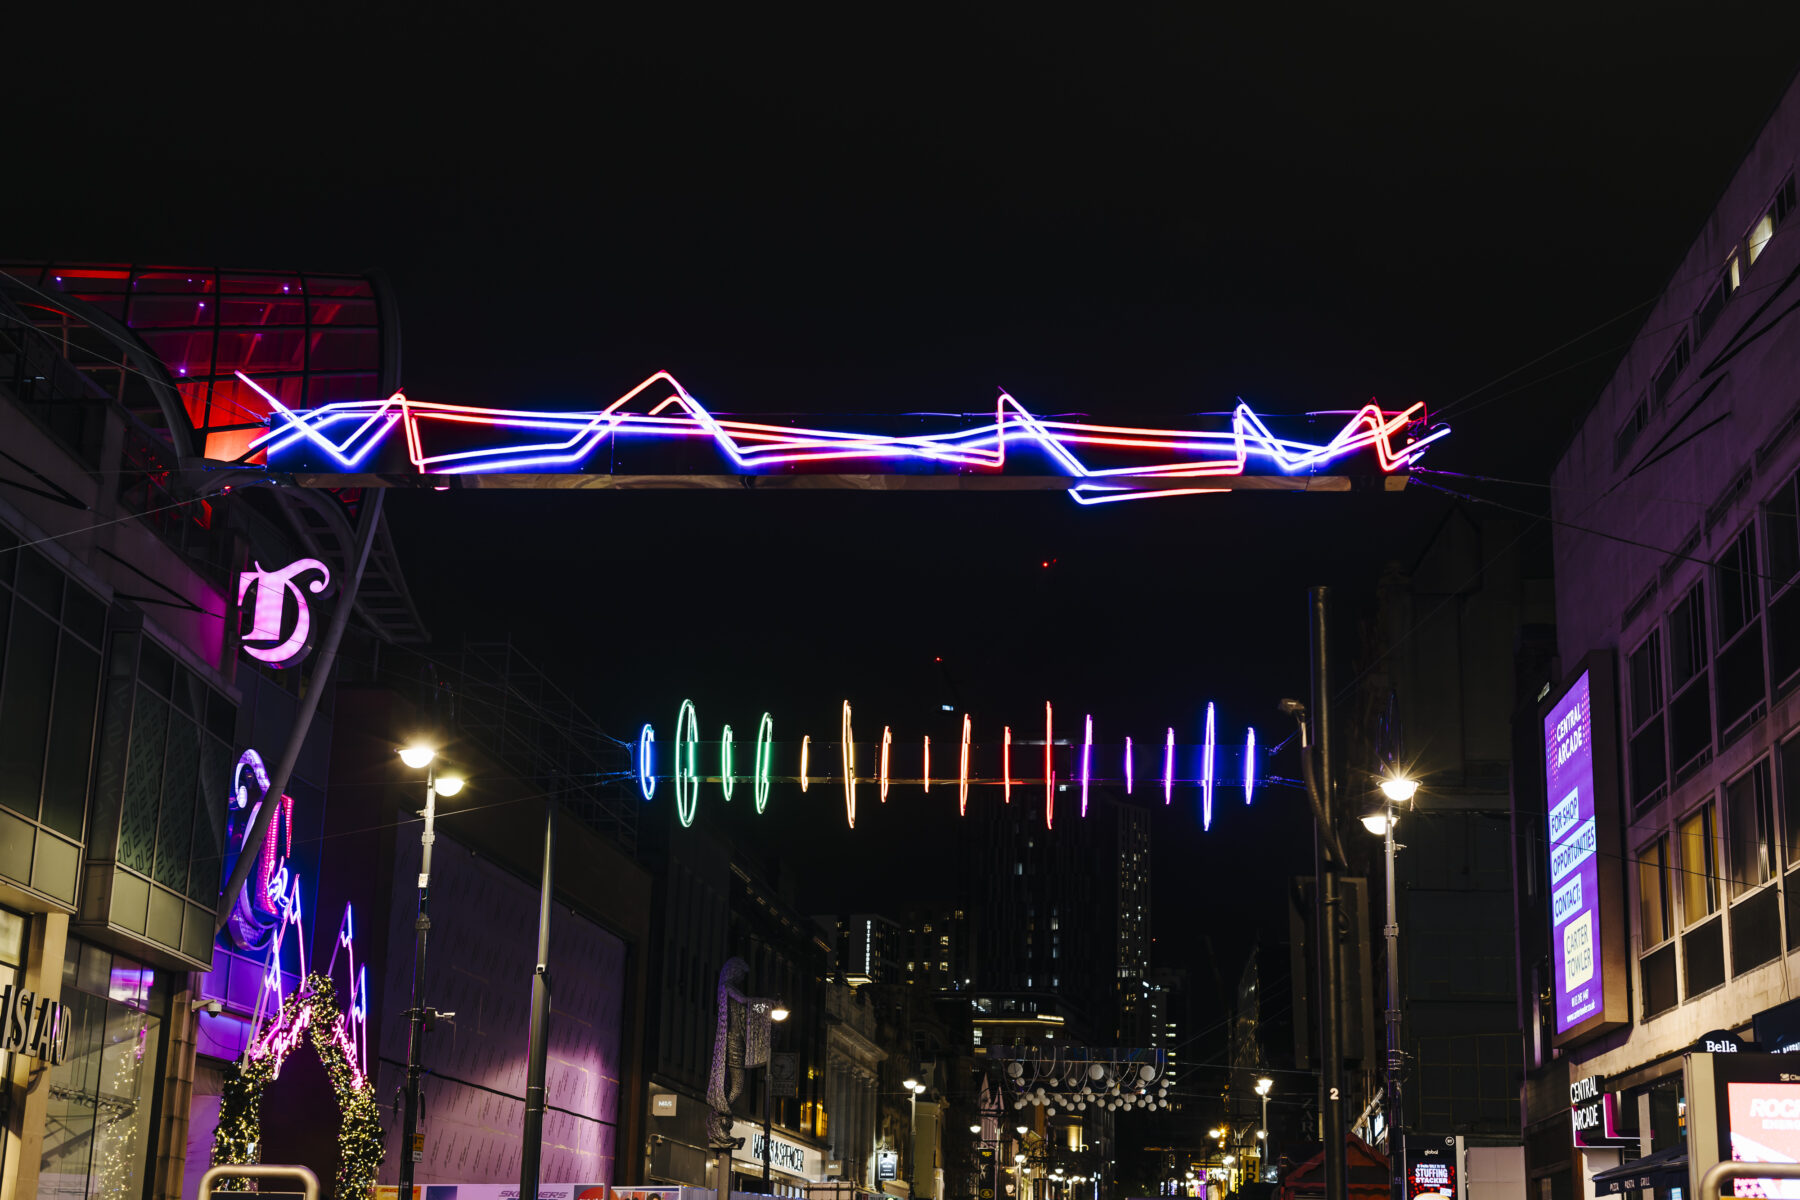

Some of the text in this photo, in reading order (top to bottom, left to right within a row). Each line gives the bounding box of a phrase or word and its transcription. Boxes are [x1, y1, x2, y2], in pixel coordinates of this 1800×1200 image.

[1556, 703, 1581, 742] CENTRAL
[1558, 725, 1583, 768] ARCADE
[1551, 797, 1577, 836] FOR SHOP
[1553, 826, 1595, 876] OPPORTUNITIES
[1566, 924, 1588, 955] CARTER
[1567, 947, 1592, 978] TOWLER
[2, 984, 72, 1066] ISLAND
[1705, 1040, 1738, 1053] Bella
[1329, 1087, 1340, 1100] 2
[1570, 1075, 1599, 1103] CENTRAL
[1574, 1104, 1599, 1131] ARCADE
[780, 1142, 804, 1172] SPENCER
[1415, 1168, 1448, 1178] STUFFING
